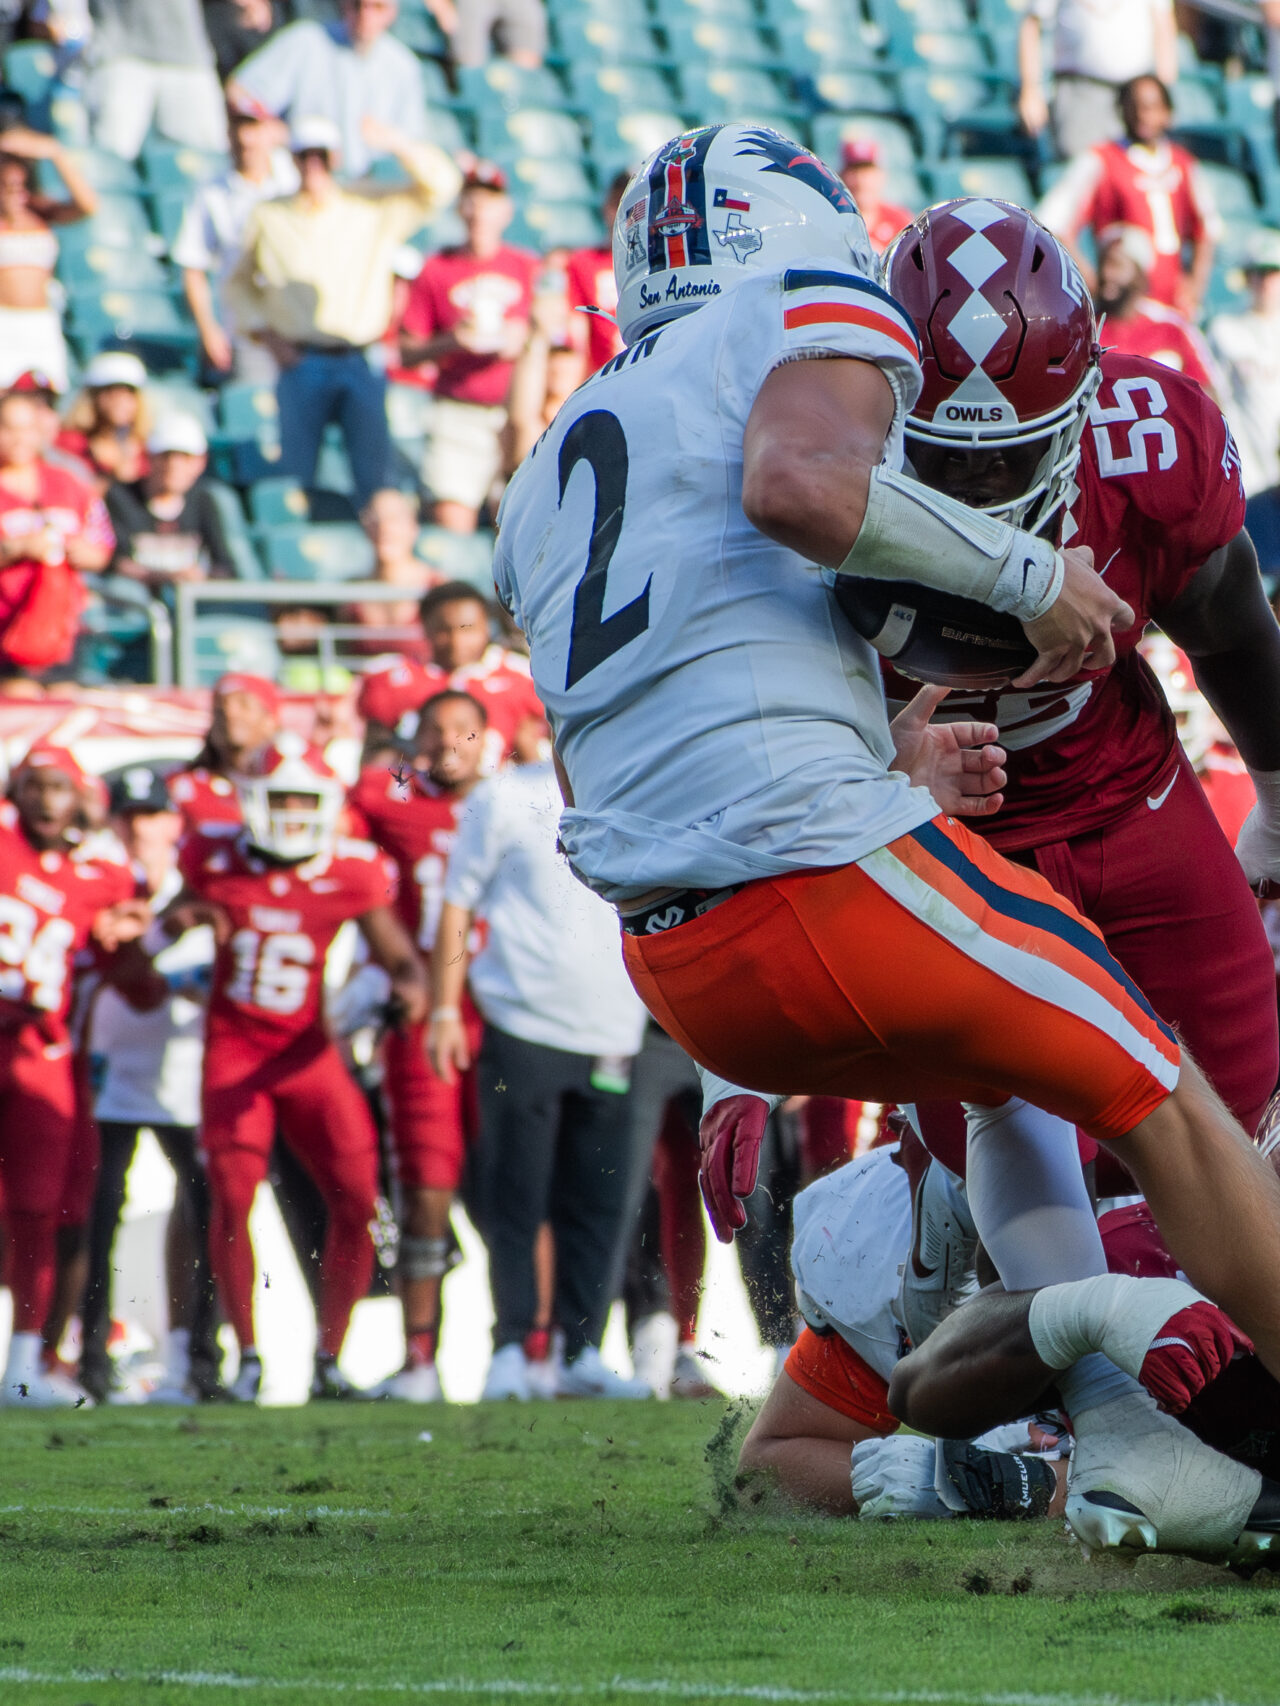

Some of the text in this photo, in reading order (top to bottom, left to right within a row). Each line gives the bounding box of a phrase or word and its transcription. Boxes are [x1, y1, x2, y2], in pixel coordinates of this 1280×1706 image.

[640, 283, 661, 309] San
[665, 273, 722, 301] Antonio
[945, 405, 1003, 422] OWLS
[1088, 376, 1178, 479] 55
[558, 409, 653, 692] 2
[226, 929, 316, 1015] 16
